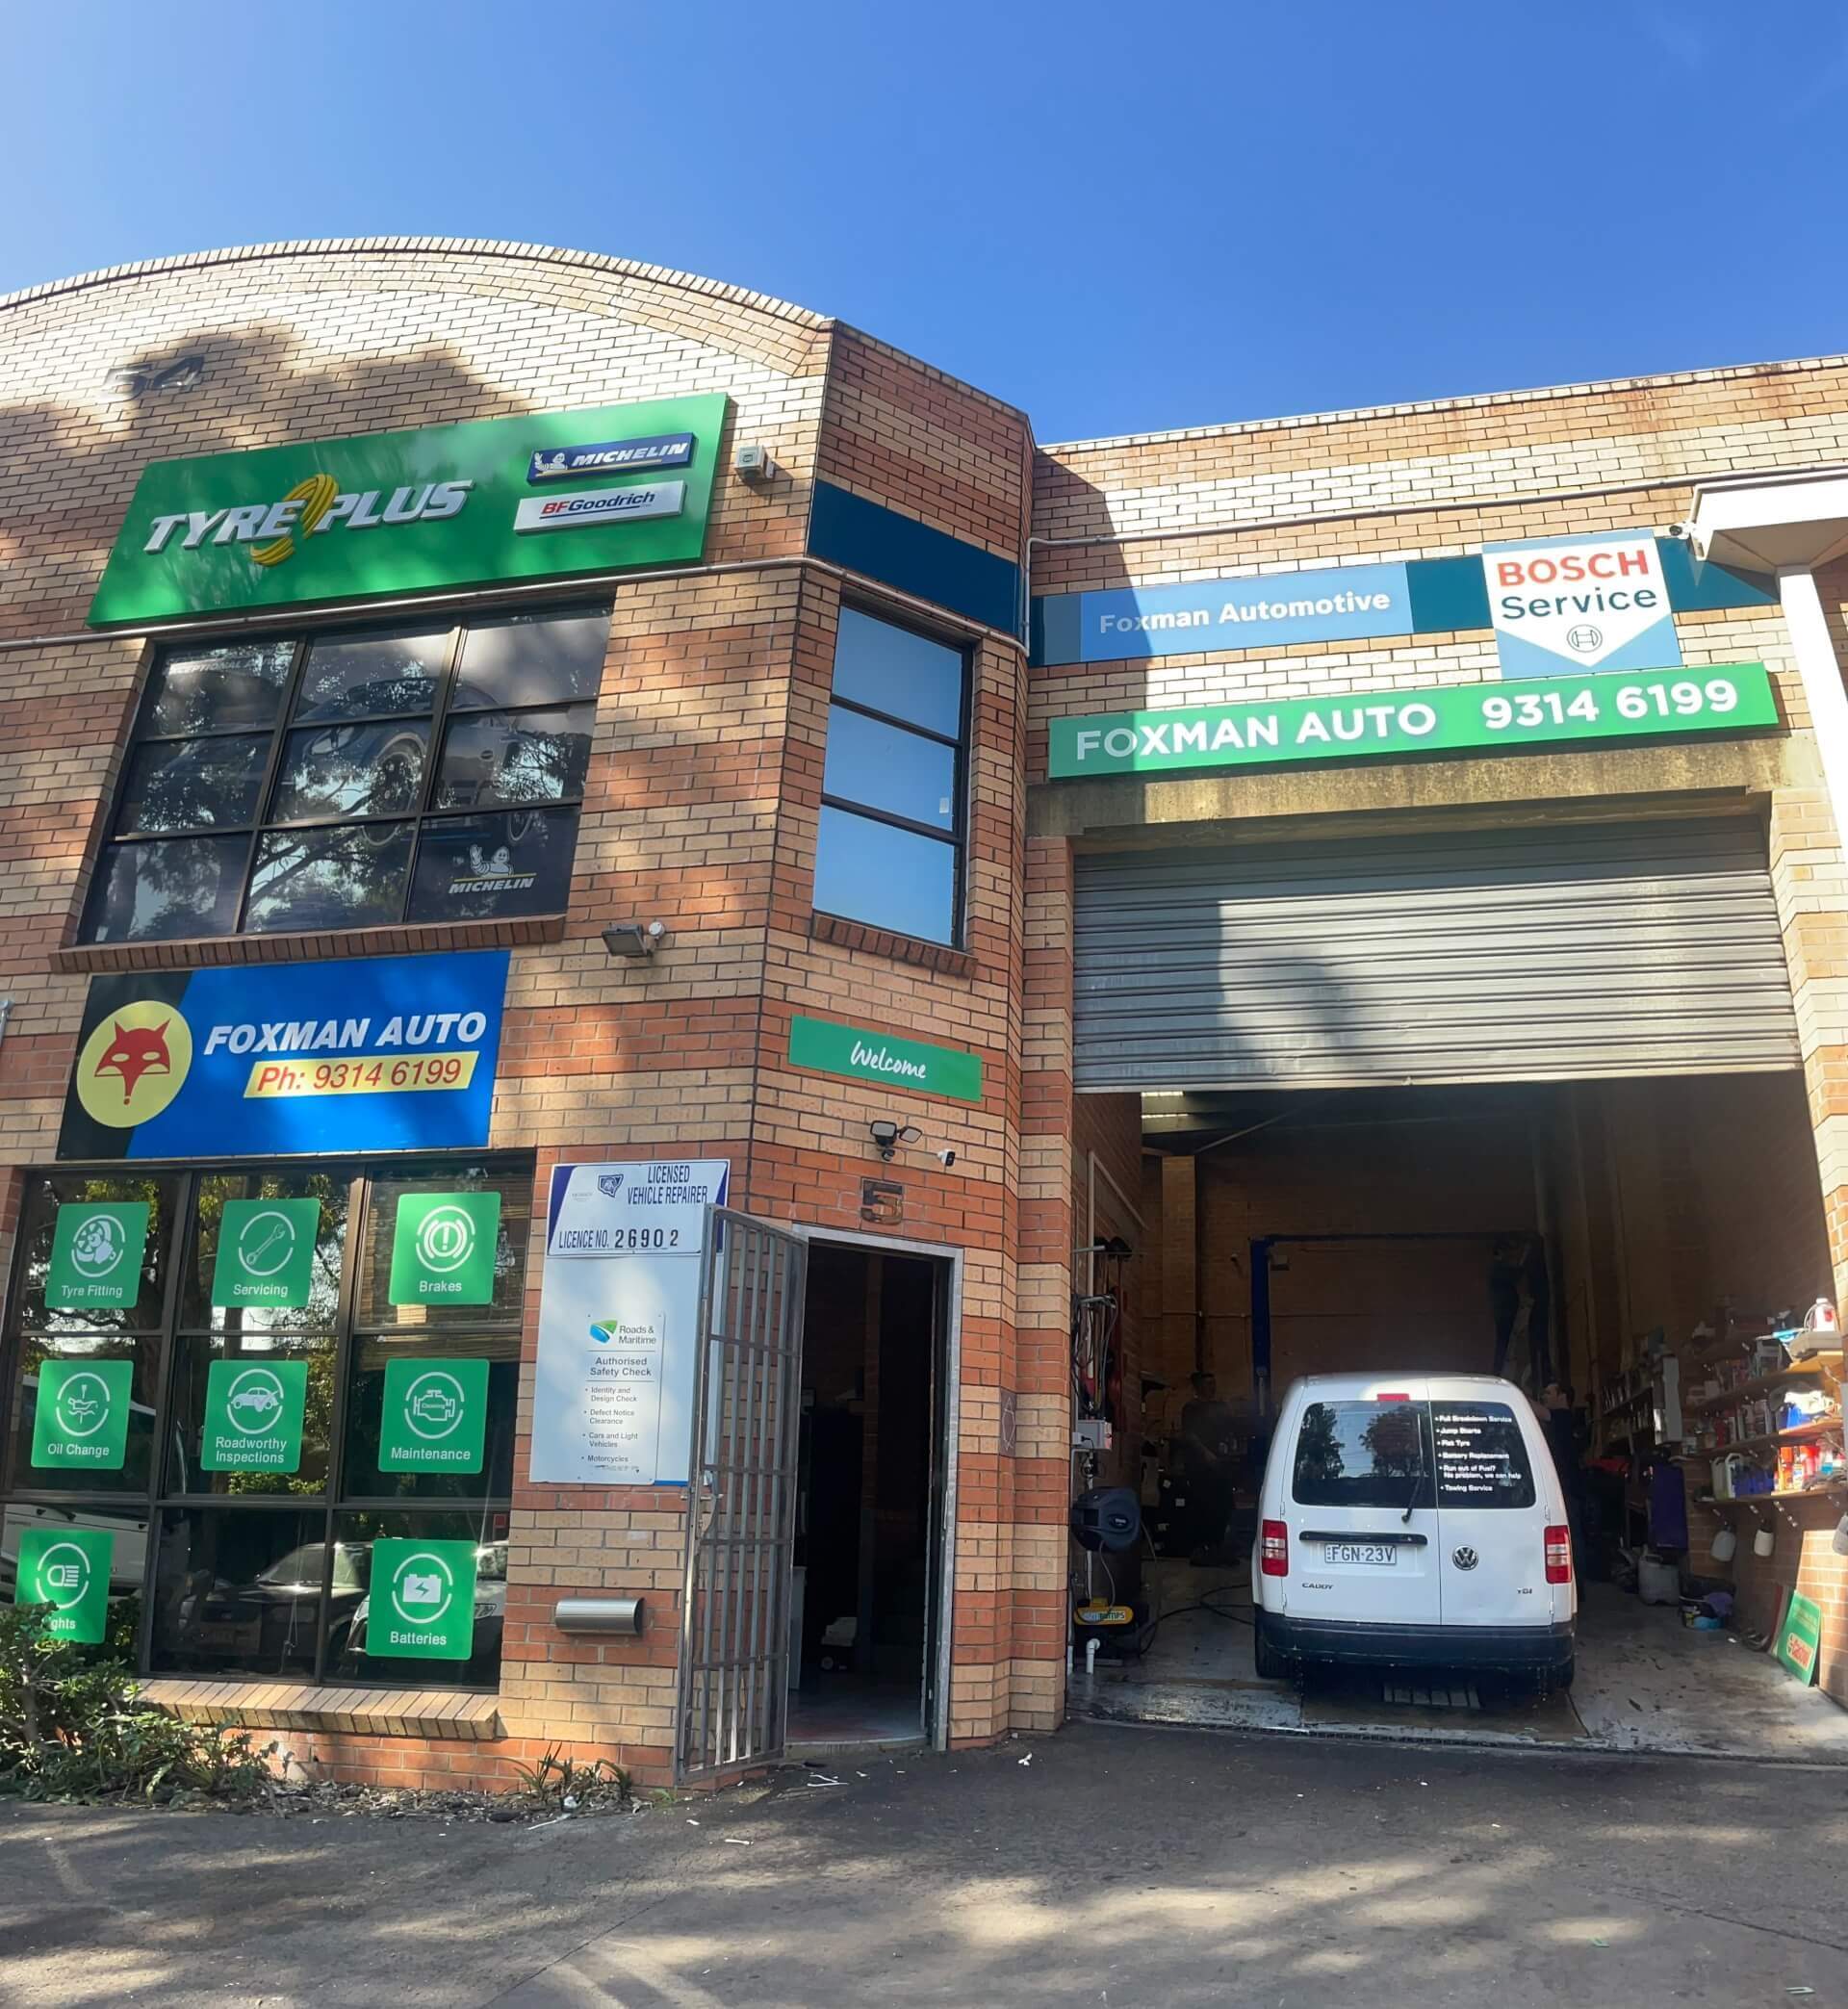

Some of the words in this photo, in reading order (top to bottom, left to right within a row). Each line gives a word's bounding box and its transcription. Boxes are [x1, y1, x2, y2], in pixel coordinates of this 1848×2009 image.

[572, 443, 688, 467] MICHELIN
[541, 492, 655, 515] BFGoodrich
[1497, 550, 1650, 587] BOSCH
[1500, 585, 1658, 621] Service
[1099, 608, 1210, 634] Foxman
[1219, 590, 1390, 626] Automotive
[1075, 714, 1279, 760] FOXMAN
[1296, 703, 1437, 744] AUTO
[1481, 690, 1600, 730] 9314
[1617, 680, 1738, 717] 6199
[449, 877, 535, 894] MICHELIN
[203, 1017, 372, 1056] FOXMAN
[375, 1012, 487, 1047] AUTO
[850, 1041, 927, 1079] Welcome
[256, 1067, 304, 1092] Ph:
[314, 1063, 381, 1090] 9314
[391, 1058, 462, 1086] 6199
[648, 1165, 690, 1184] LICENSED
[628, 1187, 664, 1205] VEHICLE
[665, 1185, 708, 1204] REPAIRER
[860, 1178, 906, 1226] 5
[559, 1230, 594, 1249] LICENCE
[595, 1230, 609, 1248] NO.
[61, 1284, 86, 1300] Tyre
[87, 1284, 123, 1301] Fitting
[232, 1282, 289, 1300] Servicing
[419, 1279, 462, 1293] Brakes
[619, 1326, 647, 1334] Roads
[648, 1326, 654, 1334] &
[619, 1336, 656, 1345] Maritime
[595, 1357, 648, 1366] Authorised
[590, 1367, 620, 1378] Safety
[622, 1367, 652, 1377] Check
[591, 1386, 616, 1395] Identity
[591, 1395, 614, 1404] Design
[621, 1431, 638, 1441] Light
[47, 1444, 63, 1455] Oil
[65, 1444, 110, 1459] Change
[216, 1437, 288, 1453] Roadworthy
[216, 1451, 285, 1466] Inspections
[391, 1447, 471, 1461] Maintenance
[587, 1455, 629, 1463] Motorcycles
[50, 1619, 77, 1632] ghts
[390, 1631, 448, 1647] Batteries
